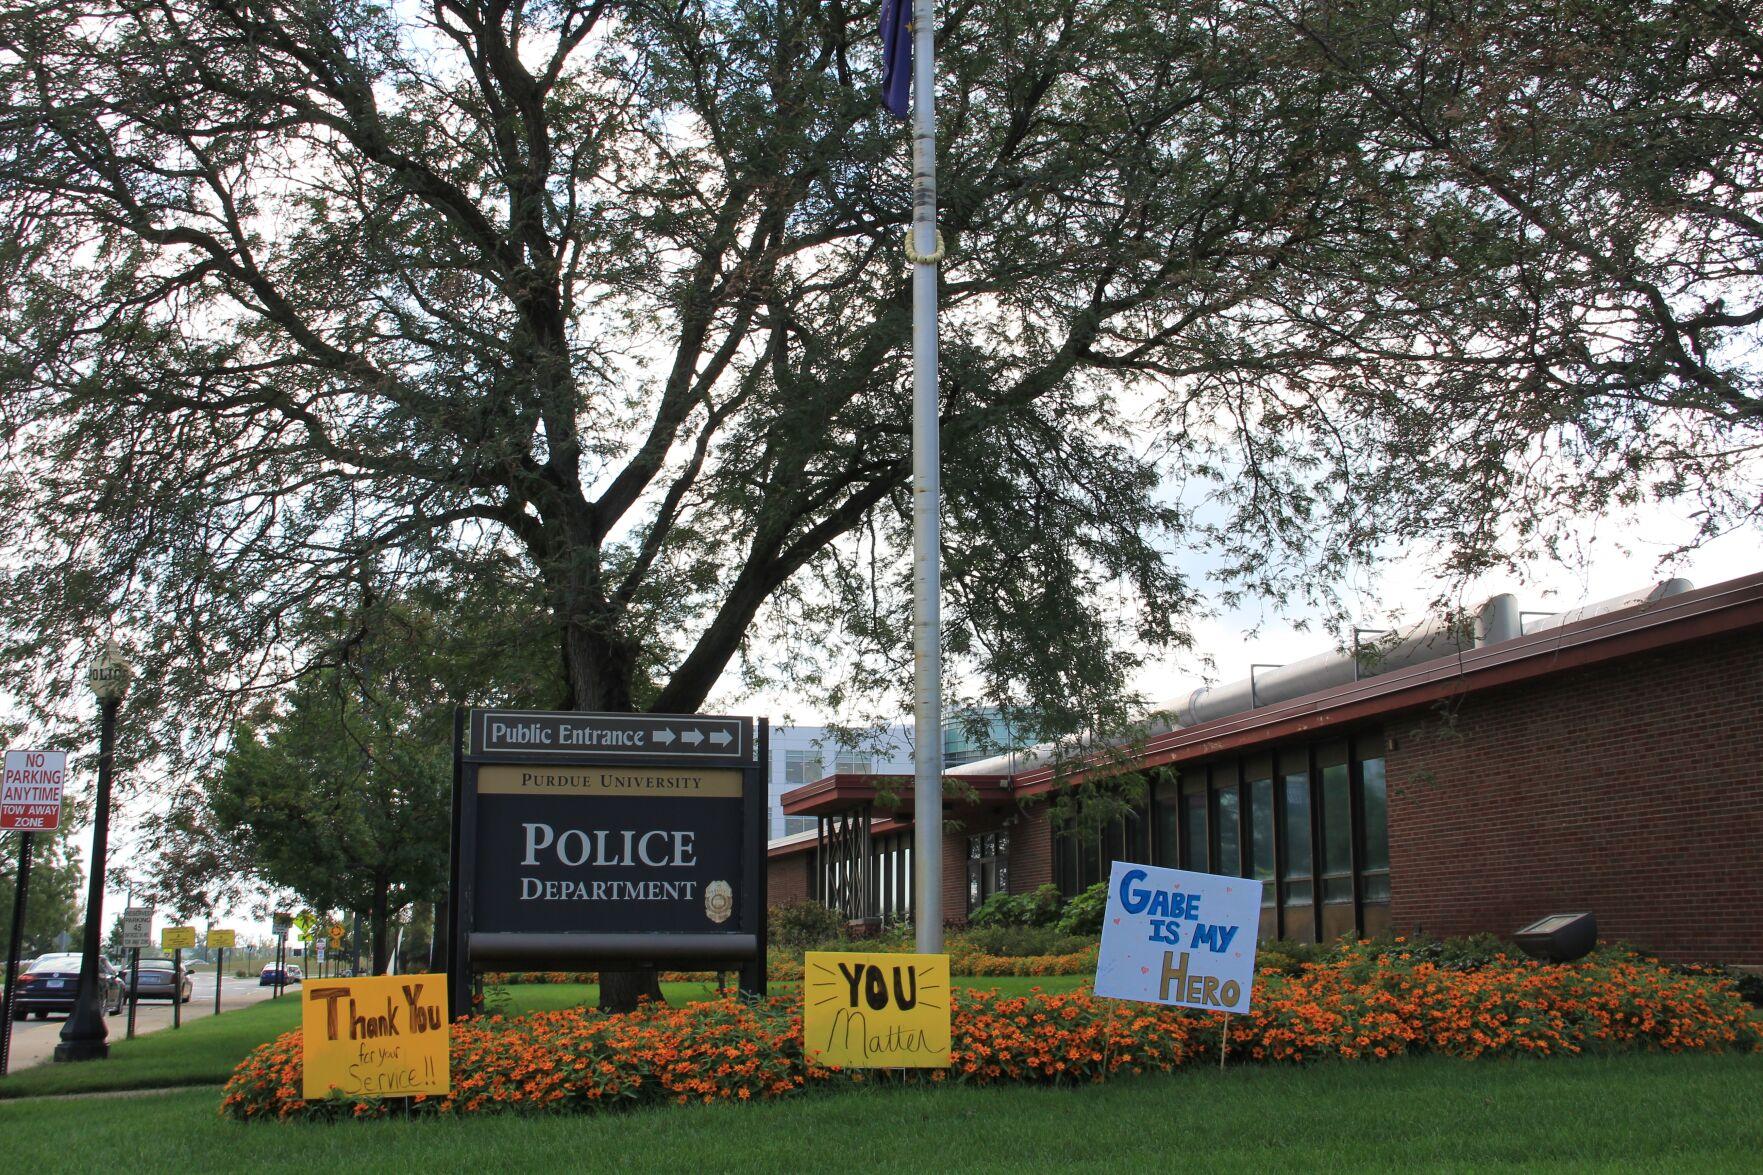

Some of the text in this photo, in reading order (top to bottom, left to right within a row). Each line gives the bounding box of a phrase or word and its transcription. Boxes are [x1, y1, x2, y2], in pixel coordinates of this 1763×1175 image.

[491, 723, 644, 746] Public Entrance
[26, 753, 44, 767] NO
[6, 770, 61, 784] PARKING
[522, 773, 702, 789] PURDUE UNIVERSITY
[4, 786, 60, 801] ANYTIME
[2, 805, 58, 815] TOW AWAY
[15, 817, 44, 827] ZONE
[520, 823, 697, 866] POLICE
[520, 878, 697, 900] DEPARTMENT
[1119, 869, 1202, 921] GABE
[133, 923, 142, 931] 45
[1149, 919, 1239, 953] IS MY
[838, 963, 916, 1011] YOU
[1159, 950, 1241, 1008] HERO
[310, 984, 442, 1041] Thank You
[827, 1008, 945, 1059] Matter
[359, 1042, 401, 1067] for your
